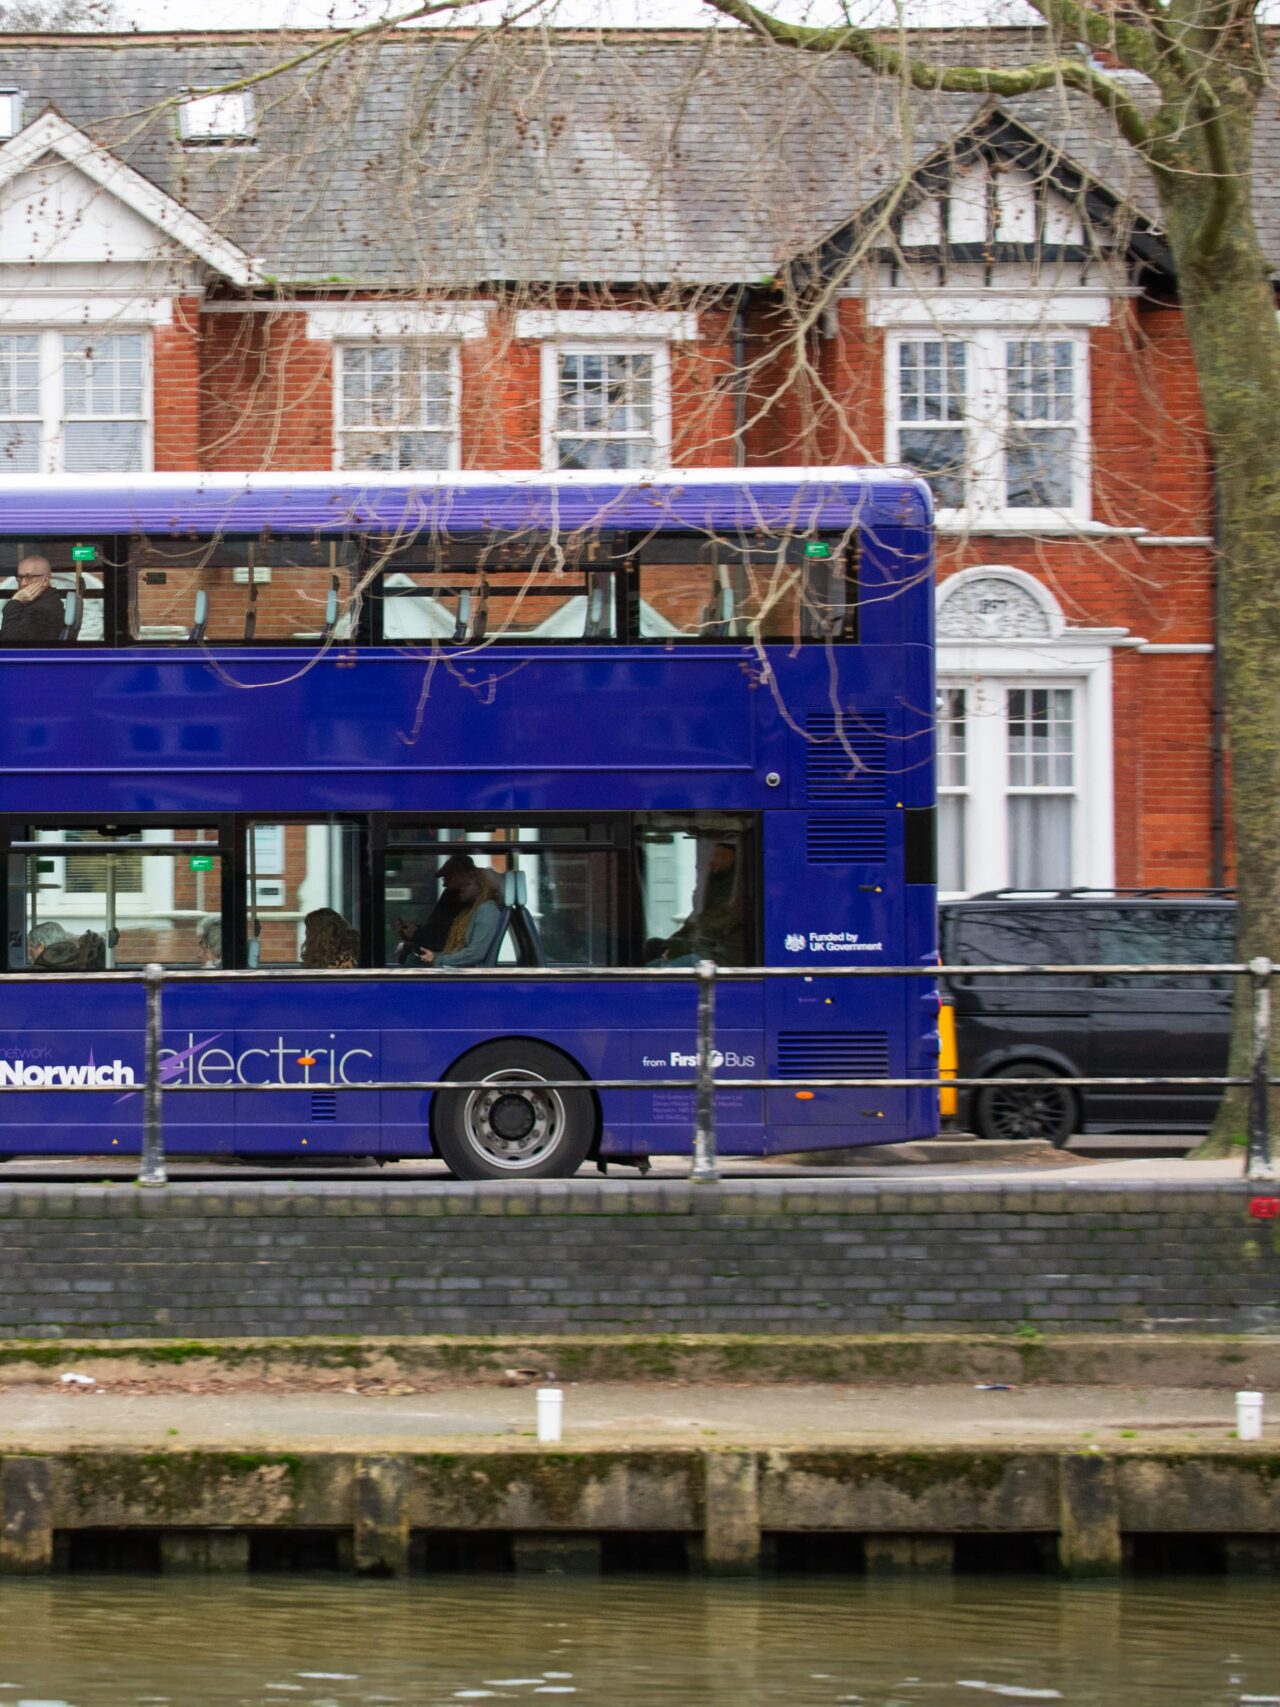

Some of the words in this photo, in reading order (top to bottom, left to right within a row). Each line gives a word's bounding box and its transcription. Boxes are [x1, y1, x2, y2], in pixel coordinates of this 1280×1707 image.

[809, 932, 844, 941] Funded
[846, 932, 858, 943] by
[809, 942, 826, 951] UK
[826, 942, 883, 951] Government
[642, 1056, 667, 1067] from
[725, 1052, 756, 1067] Bus
